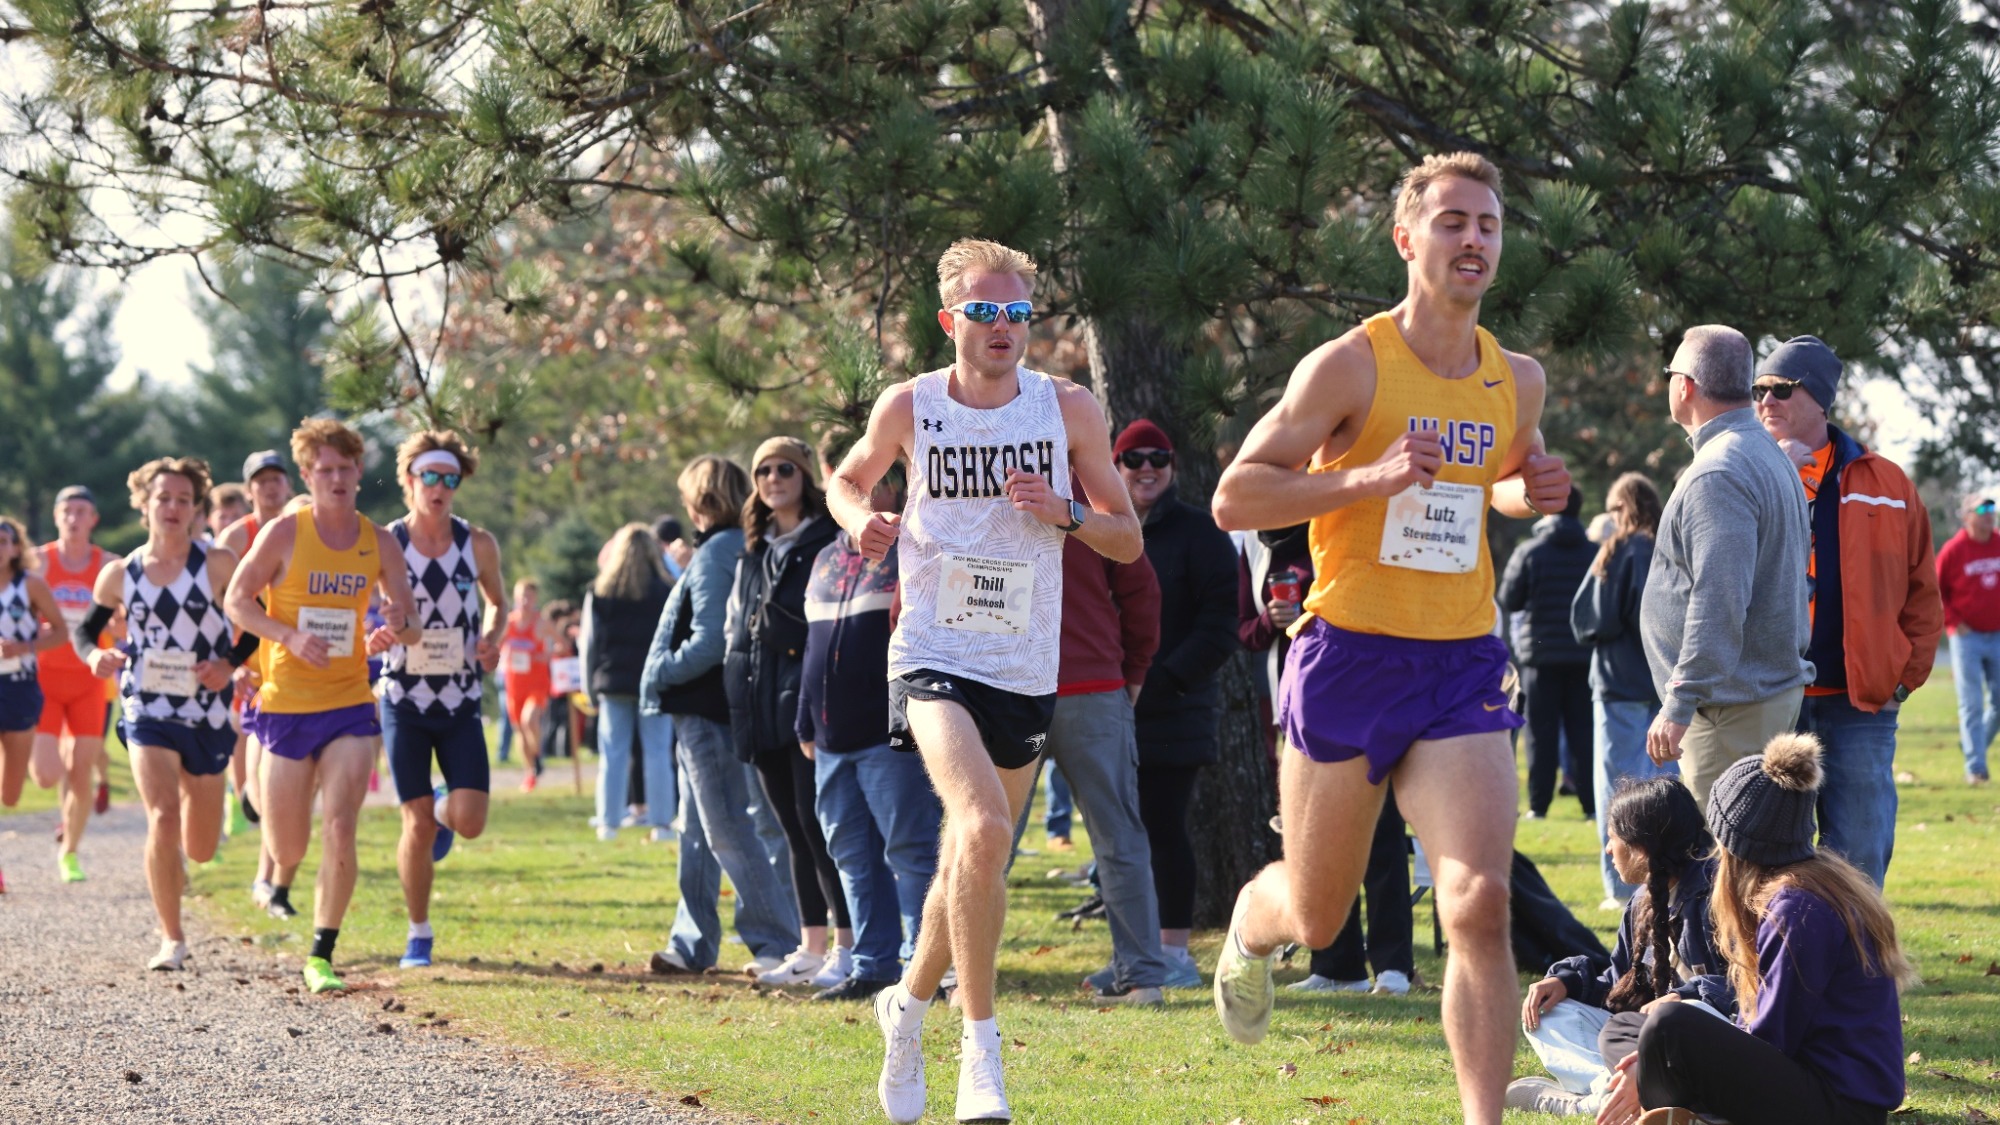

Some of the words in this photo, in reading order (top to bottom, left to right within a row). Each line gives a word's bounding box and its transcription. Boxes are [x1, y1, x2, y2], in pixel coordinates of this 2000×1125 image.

[1408, 416, 1495, 468] WSP
[1425, 504, 1456, 523] Lutz
[1402, 526, 1442, 542] Stevens
[1443, 532, 1466, 545] Point
[308, 570, 367, 597] UWSP
[973, 574, 1004, 592] Thill
[967, 596, 1004, 609] Oshkosh
